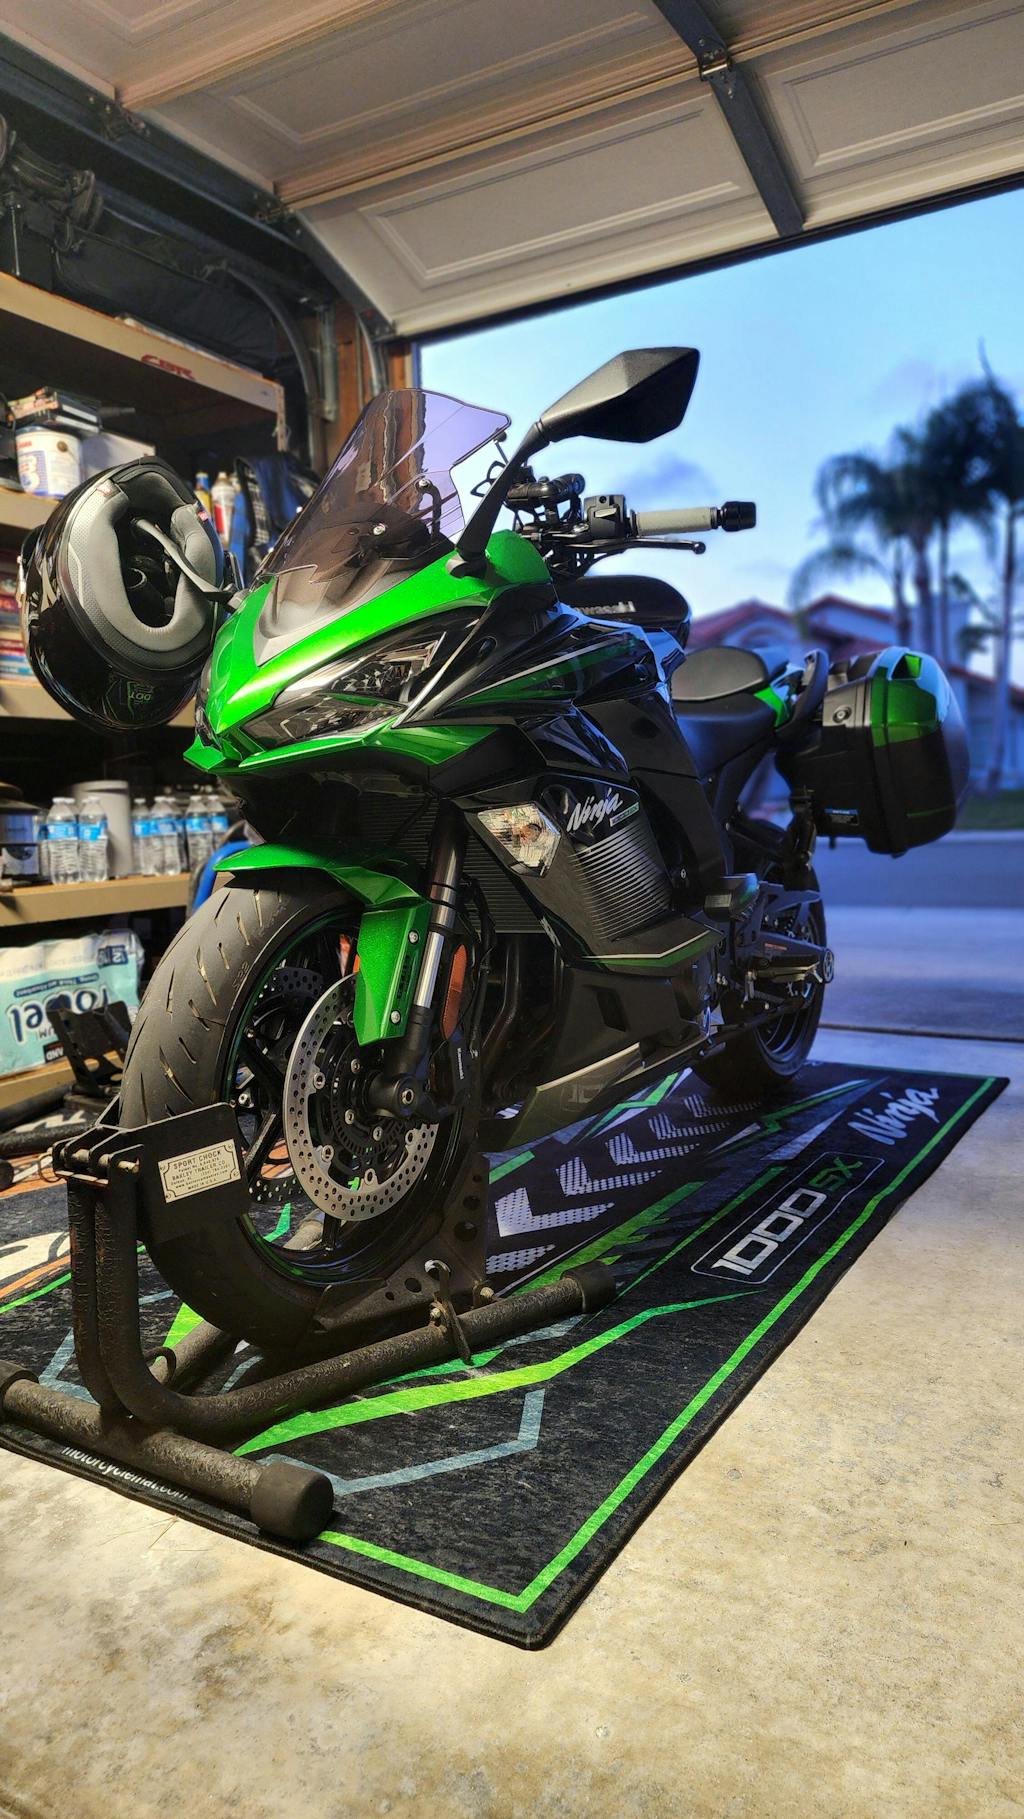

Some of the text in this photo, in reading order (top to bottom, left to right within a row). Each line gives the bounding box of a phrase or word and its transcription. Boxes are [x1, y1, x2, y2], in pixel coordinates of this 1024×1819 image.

[566, 787, 624, 832] Ninja
[847, 1086, 941, 1146] Ninja
[173, 1158, 196, 1170] SPORT
[198, 1150, 221, 1162] CHOCK
[194, 1162, 217, 1173] TRAILER
